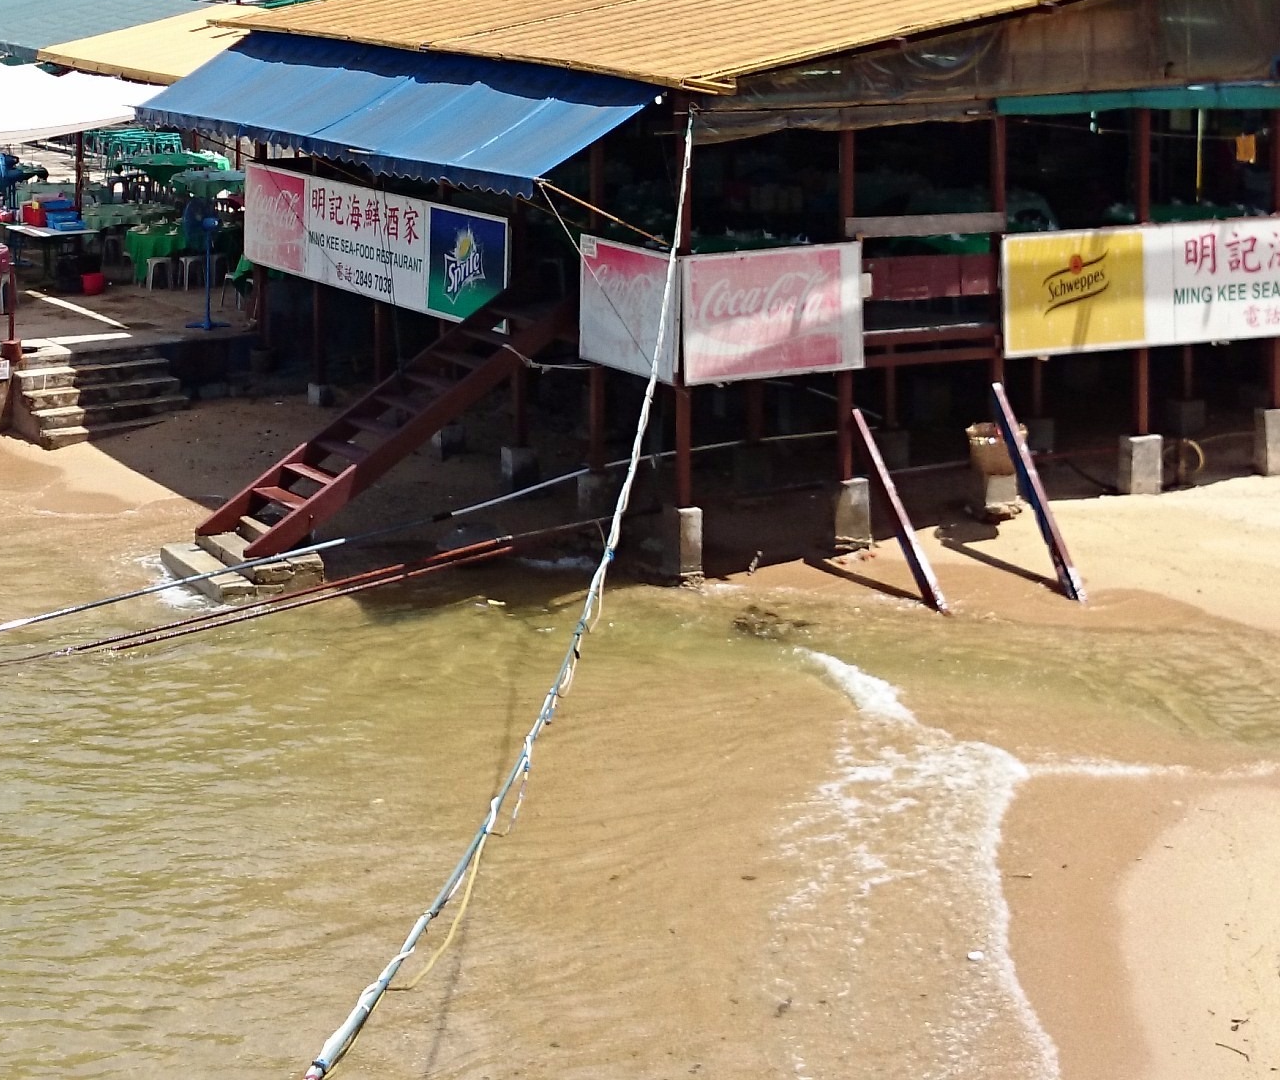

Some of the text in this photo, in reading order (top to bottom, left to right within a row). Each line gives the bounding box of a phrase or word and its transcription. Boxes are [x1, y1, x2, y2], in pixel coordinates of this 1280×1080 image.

[311, 187, 420, 246] 明記海鮮酒家
[308, 230, 423, 273] MING KEE SEA-FOOD RESTAURANT
[447, 251, 481, 293] Sprite
[355, 269, 373, 289] 2849
[374, 274, 392, 294] 7038
[699, 271, 831, 328] Coca-Cola
[1047, 268, 1106, 304] Schweppes
[1173, 285, 1213, 305] MING
[1217, 283, 1247, 302] KEE
